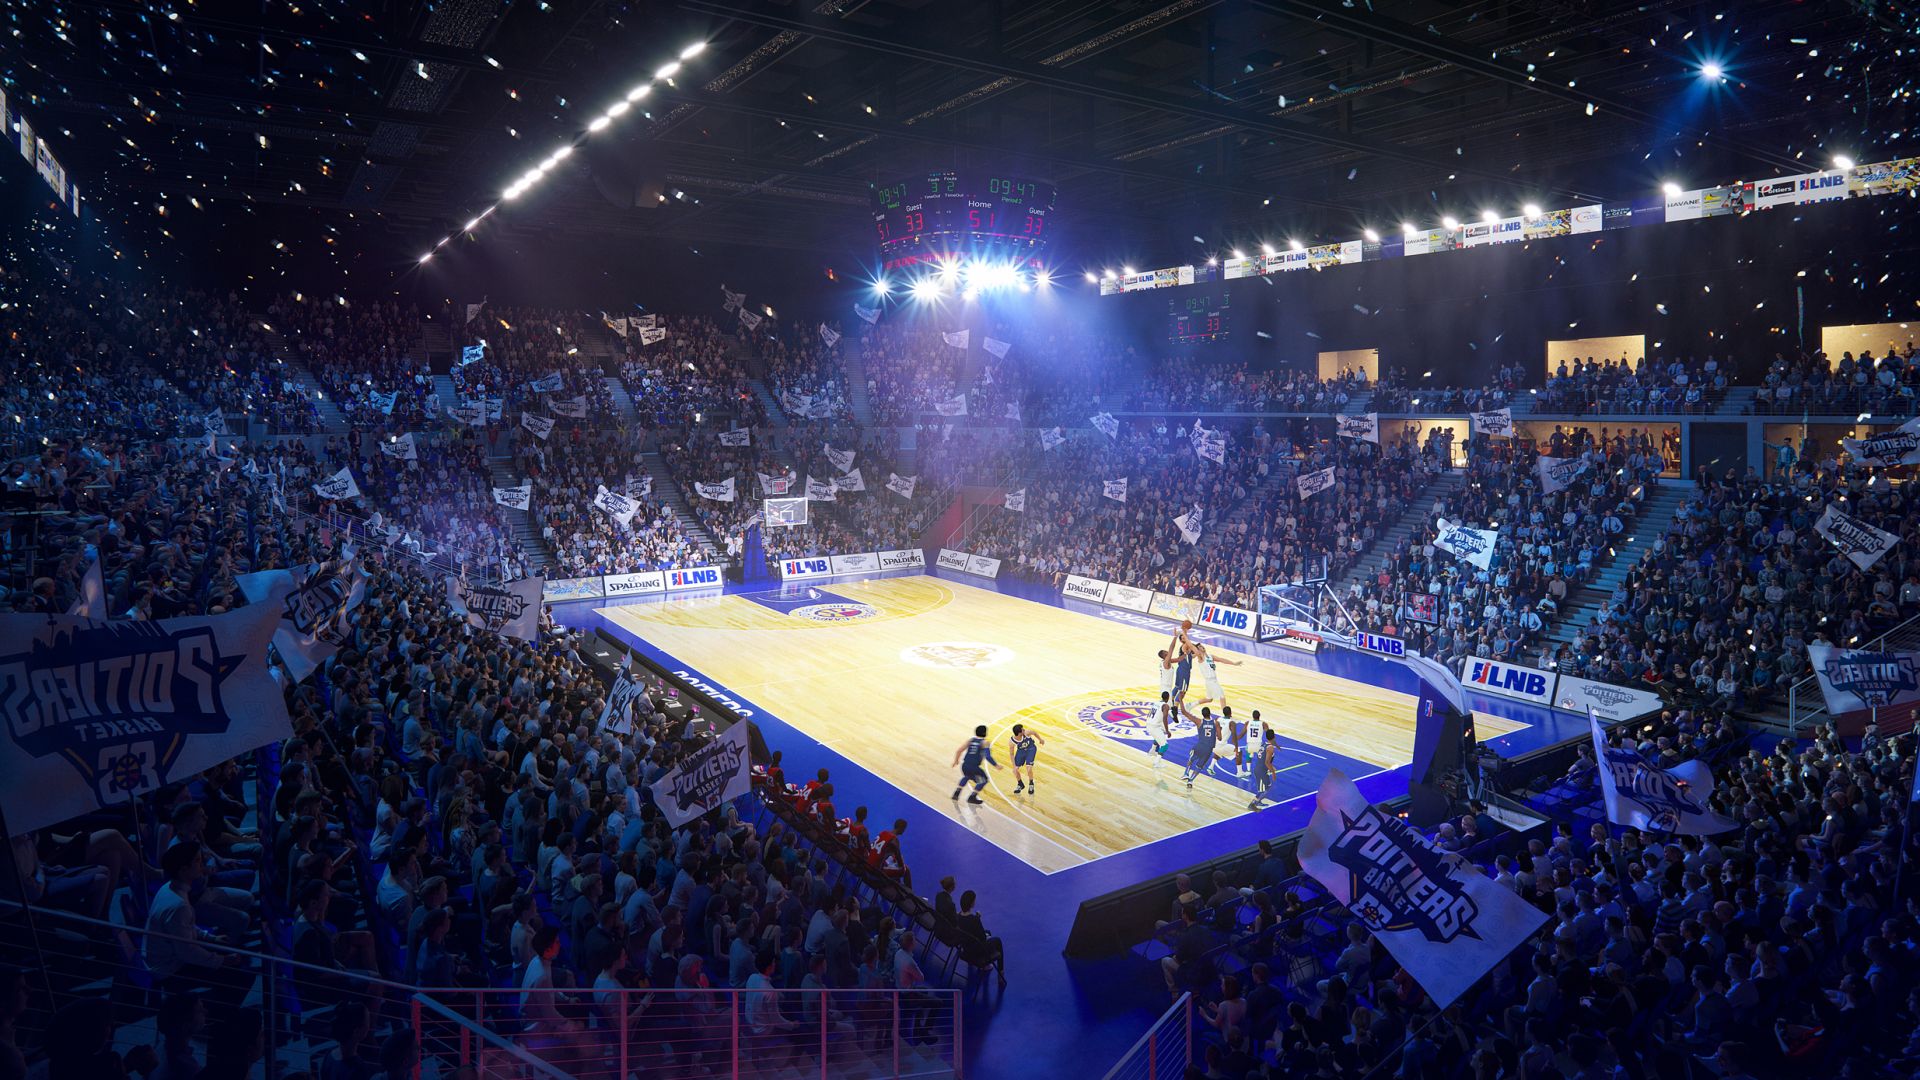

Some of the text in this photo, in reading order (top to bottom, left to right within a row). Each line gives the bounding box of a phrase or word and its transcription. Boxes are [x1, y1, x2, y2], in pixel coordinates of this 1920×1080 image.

[931, 182, 938, 192] 3
[990, 178, 1035, 198] 09:47
[1810, 175, 1844, 191] LNB
[880, 184, 907, 205] 09:47
[906, 203, 922, 212] Guest
[968, 200, 992, 208] Home
[1029, 207, 1045, 216] Guest
[906, 213, 923, 233] 33
[969, 210, 995, 228] 51
[1024, 216, 1043, 234] 33
[1499, 221, 1521, 232] LNB
[878, 223, 889, 240] 51
[1291, 252, 1307, 262] LNB
[1177, 321, 1190, 335] 51
[1207, 318, 1220, 332] 33
[1480, 414, 1509, 426] POITIERS
[1864, 433, 1917, 457] POITIERS
[1447, 528, 1487, 551] POITIERS
[1832, 515, 1885, 553] POITIERS
[796, 559, 828, 574] LNB
[940, 556, 964, 567] SPALDING
[683, 569, 718, 585] LNB
[609, 579, 660, 592] SPALDING
[1066, 582, 1102, 598] SPALDING
[466, 590, 522, 616] POITIERS
[1211, 610, 1248, 630] LNB
[1368, 637, 1403, 655] LNB
[1488, 668, 1546, 696] LNB
[1584, 685, 1633, 704] POITIERS
[1204, 728, 1212, 738] 15
[1249, 727, 1259, 738] 15
[675, 748, 741, 800] POITIERS
[1337, 810, 1476, 940] POITIERS
[1363, 867, 1415, 916] BASKET
